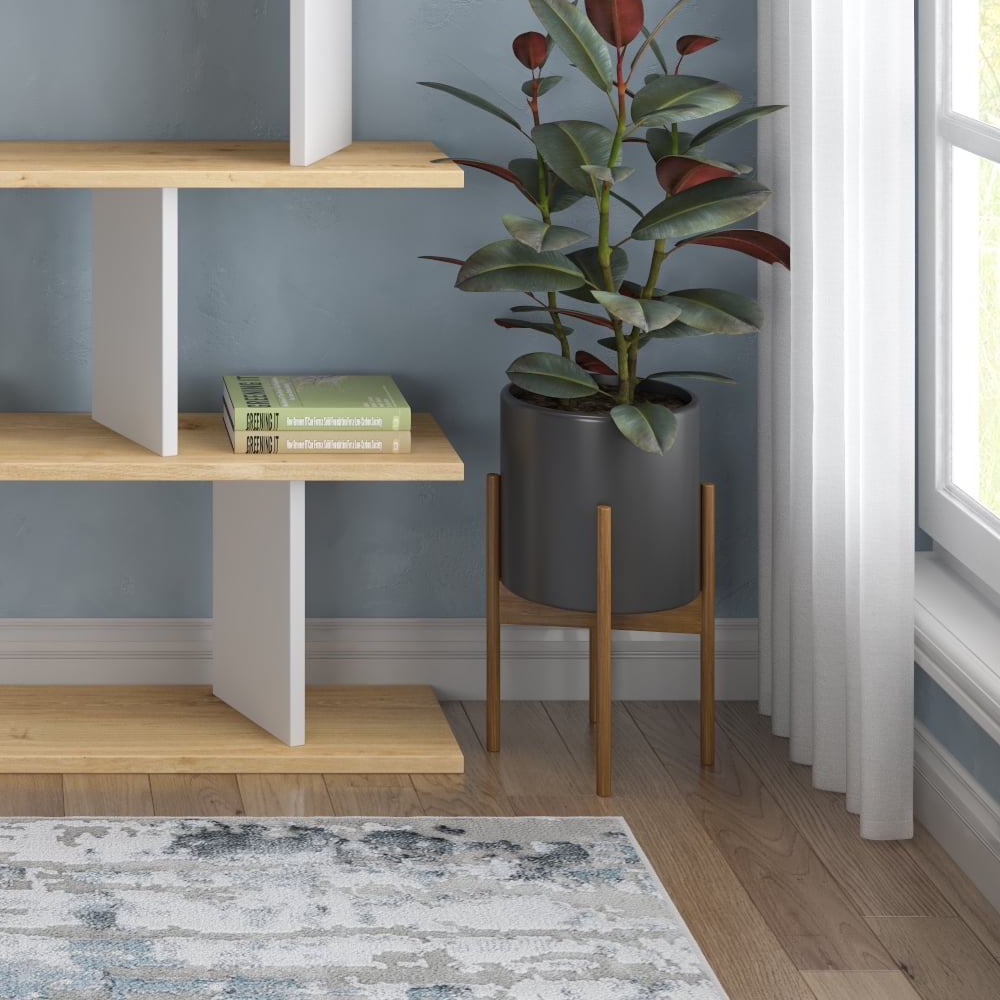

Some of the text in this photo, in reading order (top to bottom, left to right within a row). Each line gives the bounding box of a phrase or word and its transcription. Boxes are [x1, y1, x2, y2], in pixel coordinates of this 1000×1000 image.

[246, 412, 273, 431] GREENING
[273, 412, 280, 431] IT
[246, 436, 273, 454] GREENING
[273, 436, 280, 454] IT
